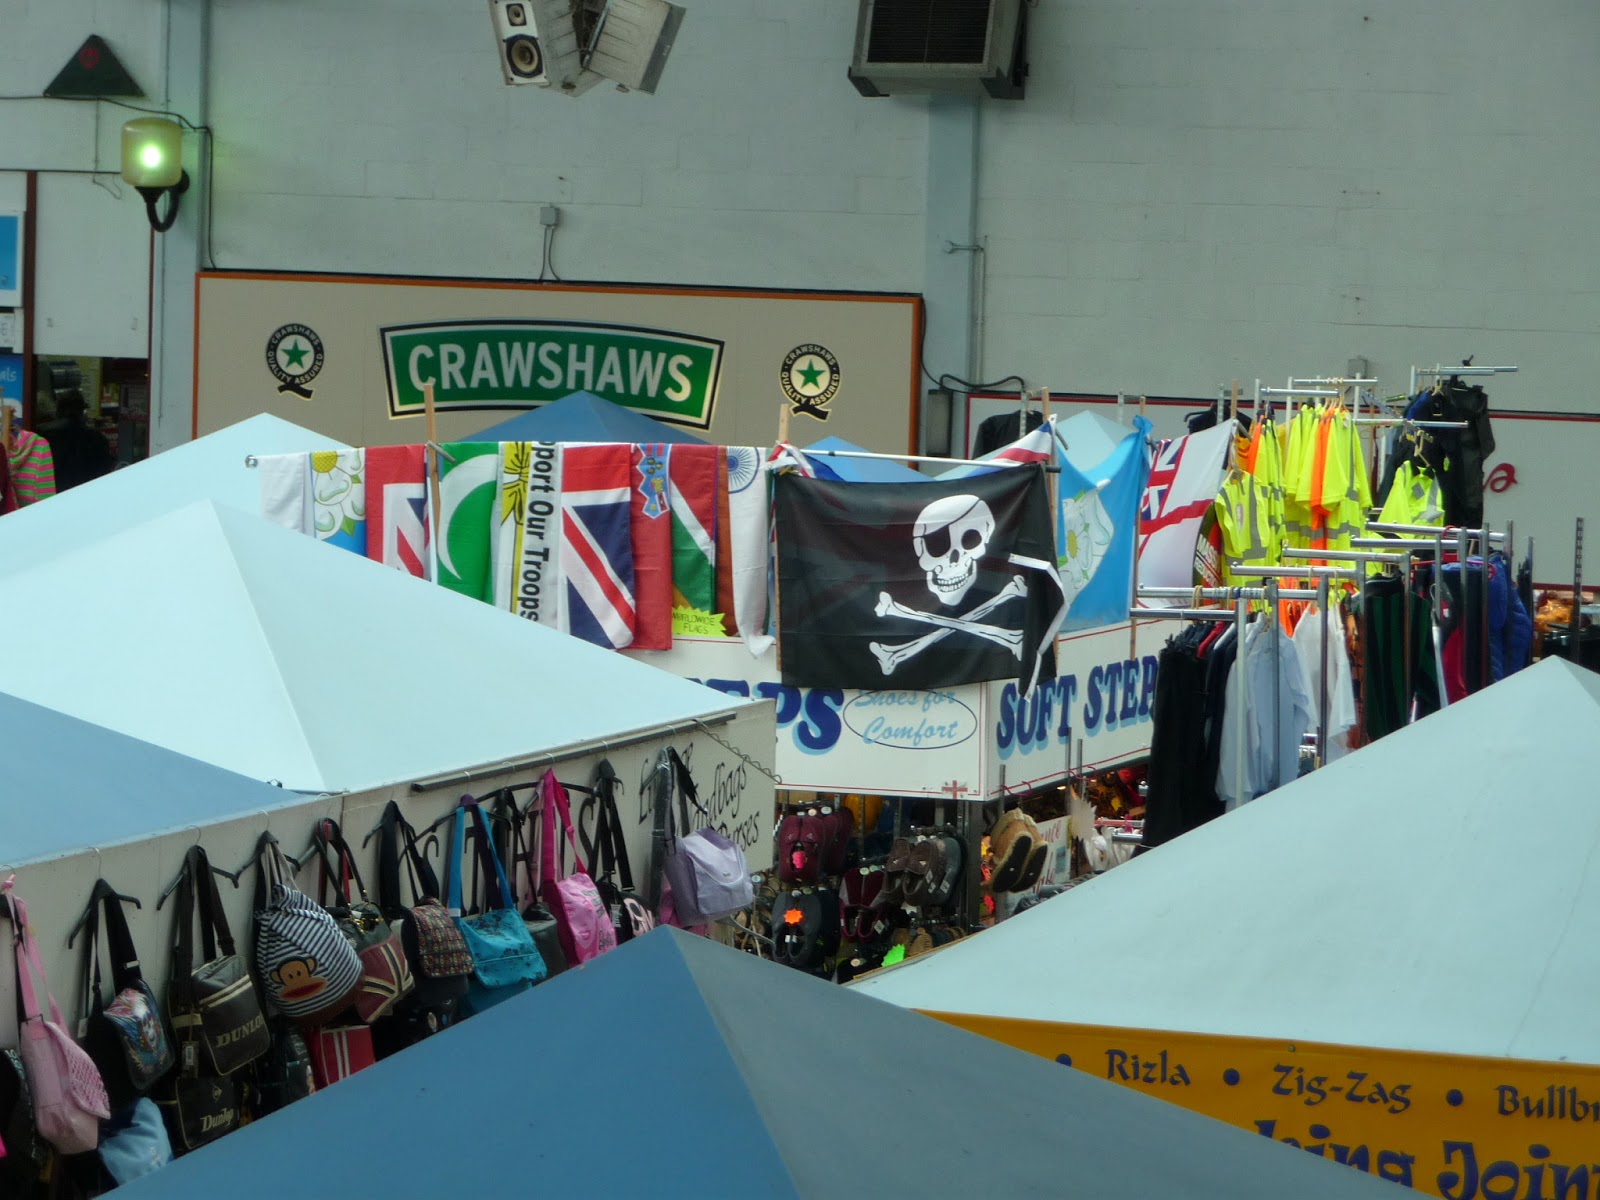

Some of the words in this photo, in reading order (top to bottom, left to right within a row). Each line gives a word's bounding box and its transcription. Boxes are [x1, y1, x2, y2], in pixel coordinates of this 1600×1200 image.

[272, 325, 320, 346] CRAWSHAWS
[267, 351, 292, 383] QUALITY
[294, 353, 324, 384] ASSURED
[409, 341, 694, 402] CRAWSHAWS
[785, 345, 836, 365] CRAWSHAWS
[782, 371, 807, 404] QUALITY
[809, 373, 839, 405] ASSURED
[526, 500, 554, 540] Our
[517, 548, 549, 622] Troops
[683, 622, 709, 635] FLAGS
[996, 674, 1078, 761] SOFT
[1083, 654, 1158, 738] STEP
[863, 716, 959, 744] Comfort
[1104, 1049, 1192, 1087] Rizla
[1271, 1063, 1412, 1115] Zig-Zag
